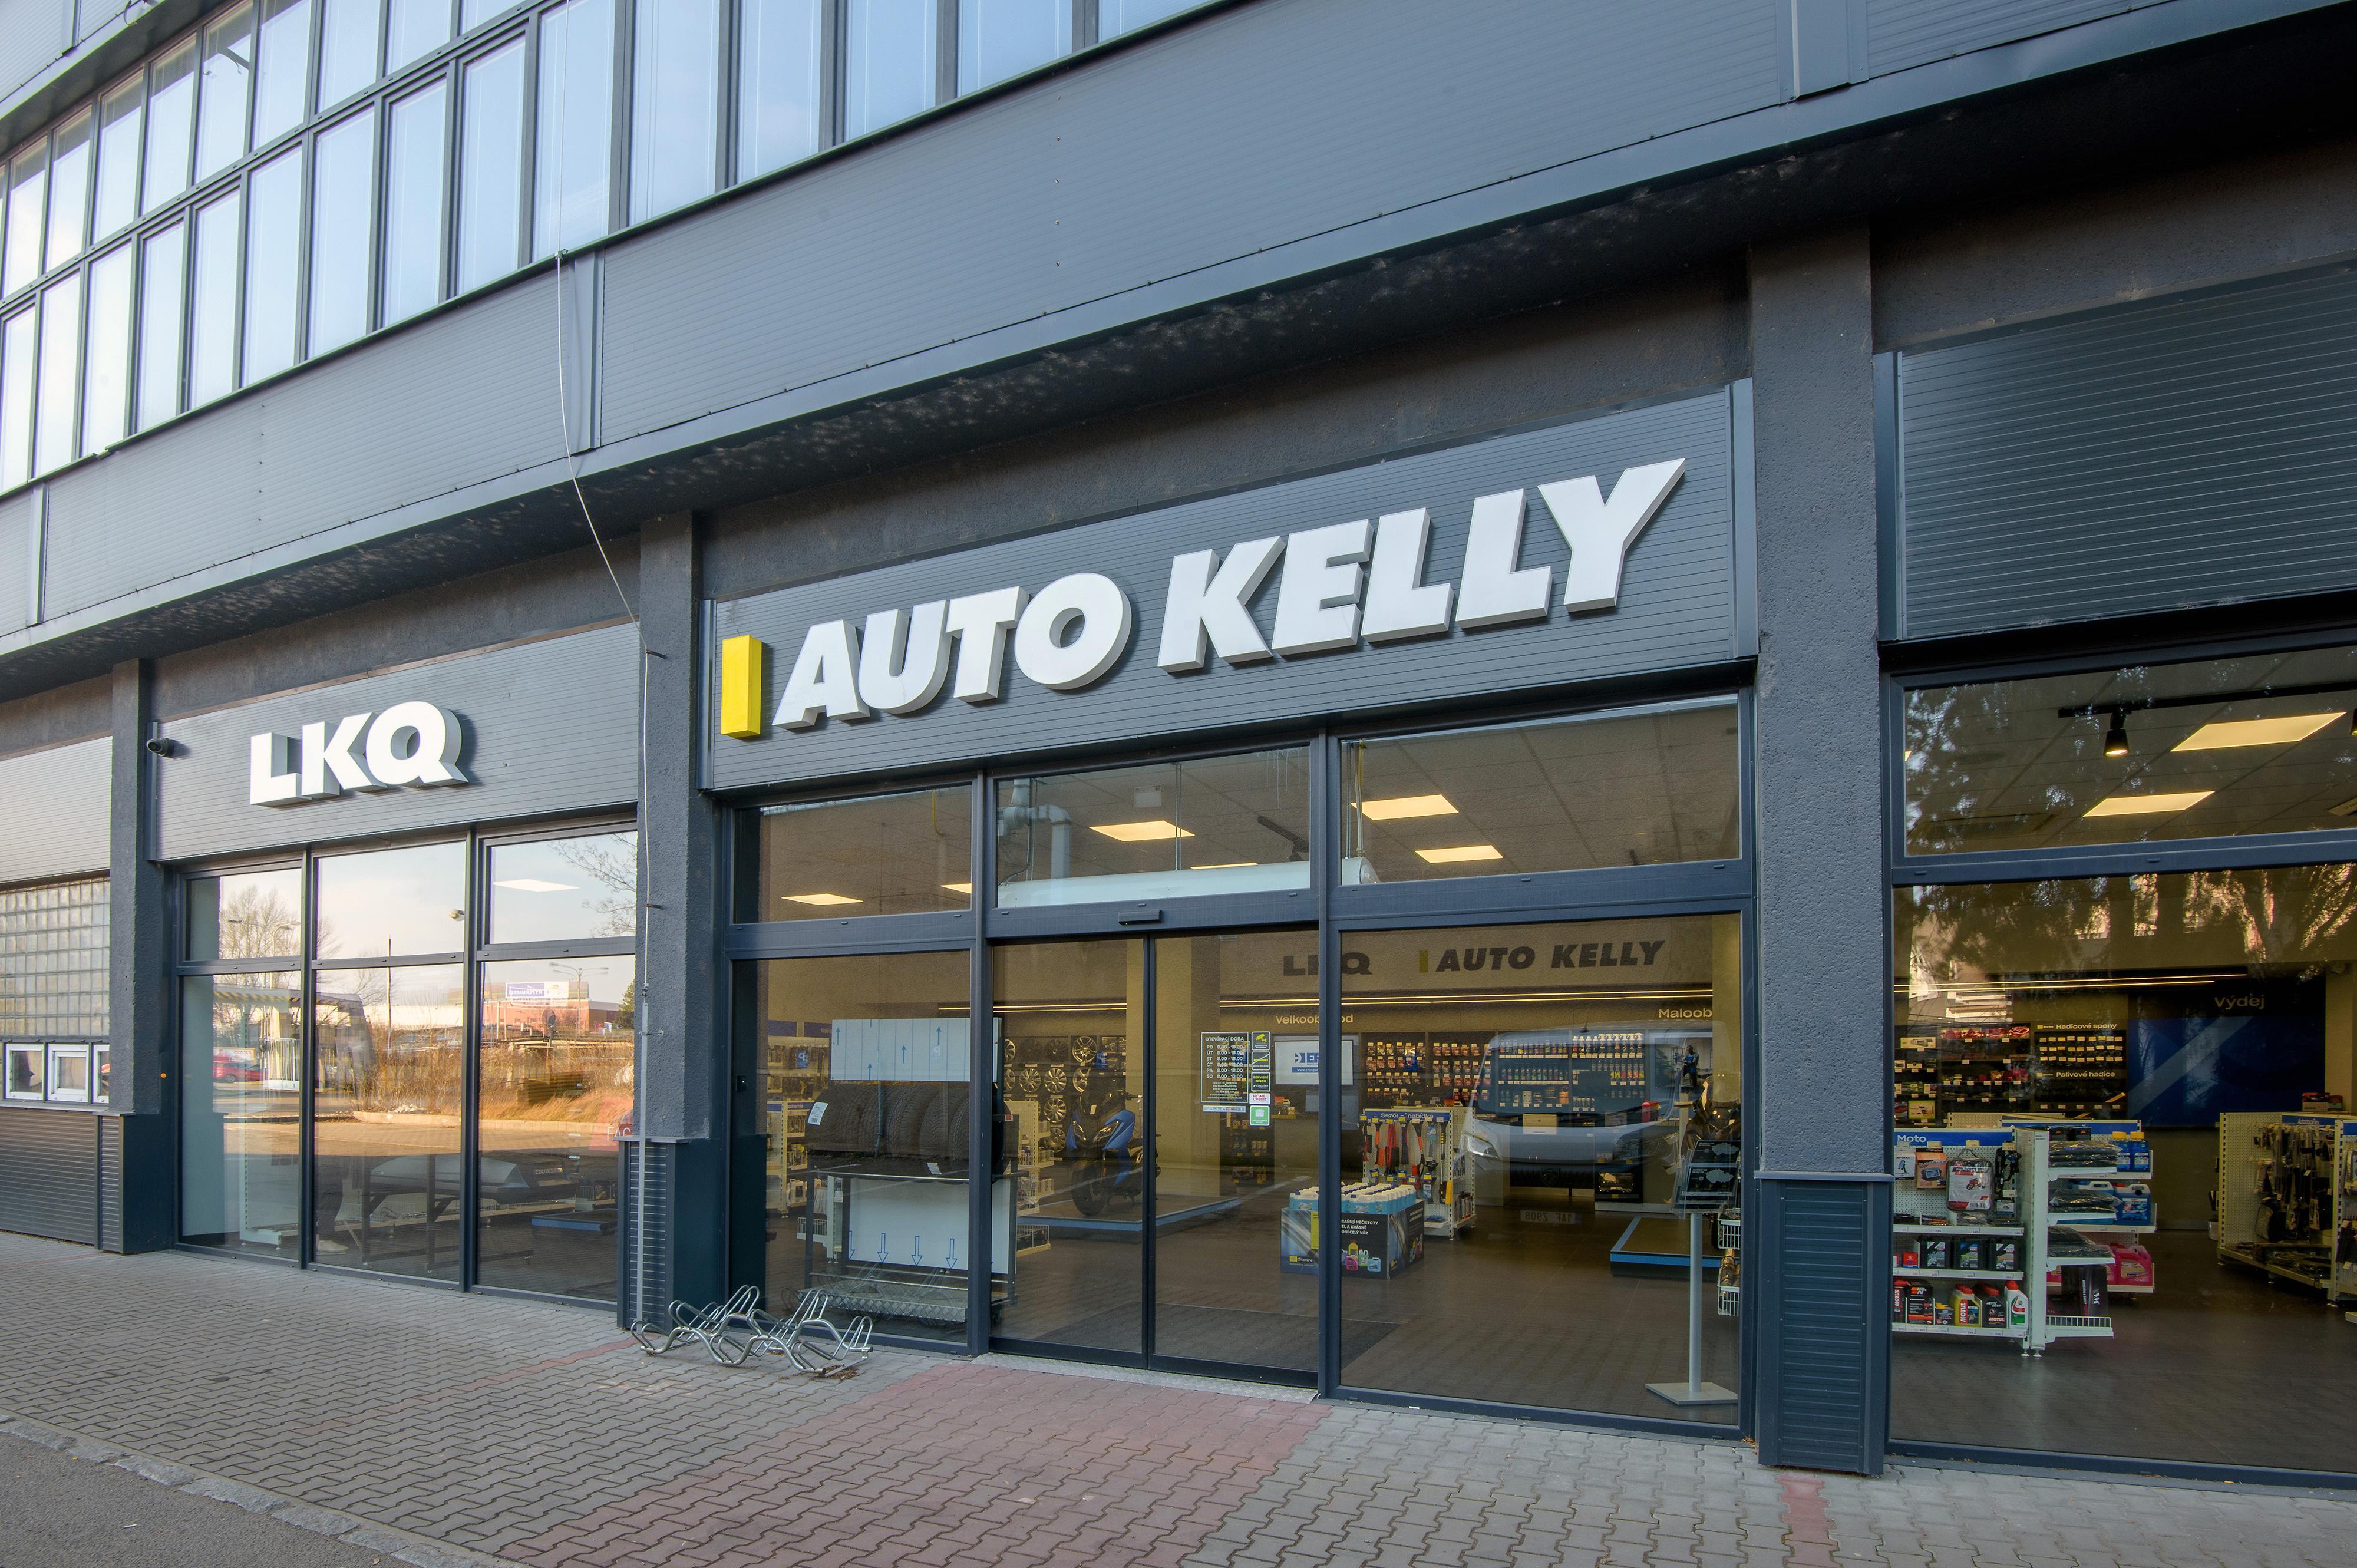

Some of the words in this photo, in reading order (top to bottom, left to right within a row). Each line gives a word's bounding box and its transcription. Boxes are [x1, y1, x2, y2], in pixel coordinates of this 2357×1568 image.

[772, 572, 1131, 731] AUTO
[1156, 458, 1685, 673] KELLY
[250, 701, 466, 807] LKQ
[1435, 946, 1536, 972] AUTO
[1551, 940, 1665, 969] KELLY
